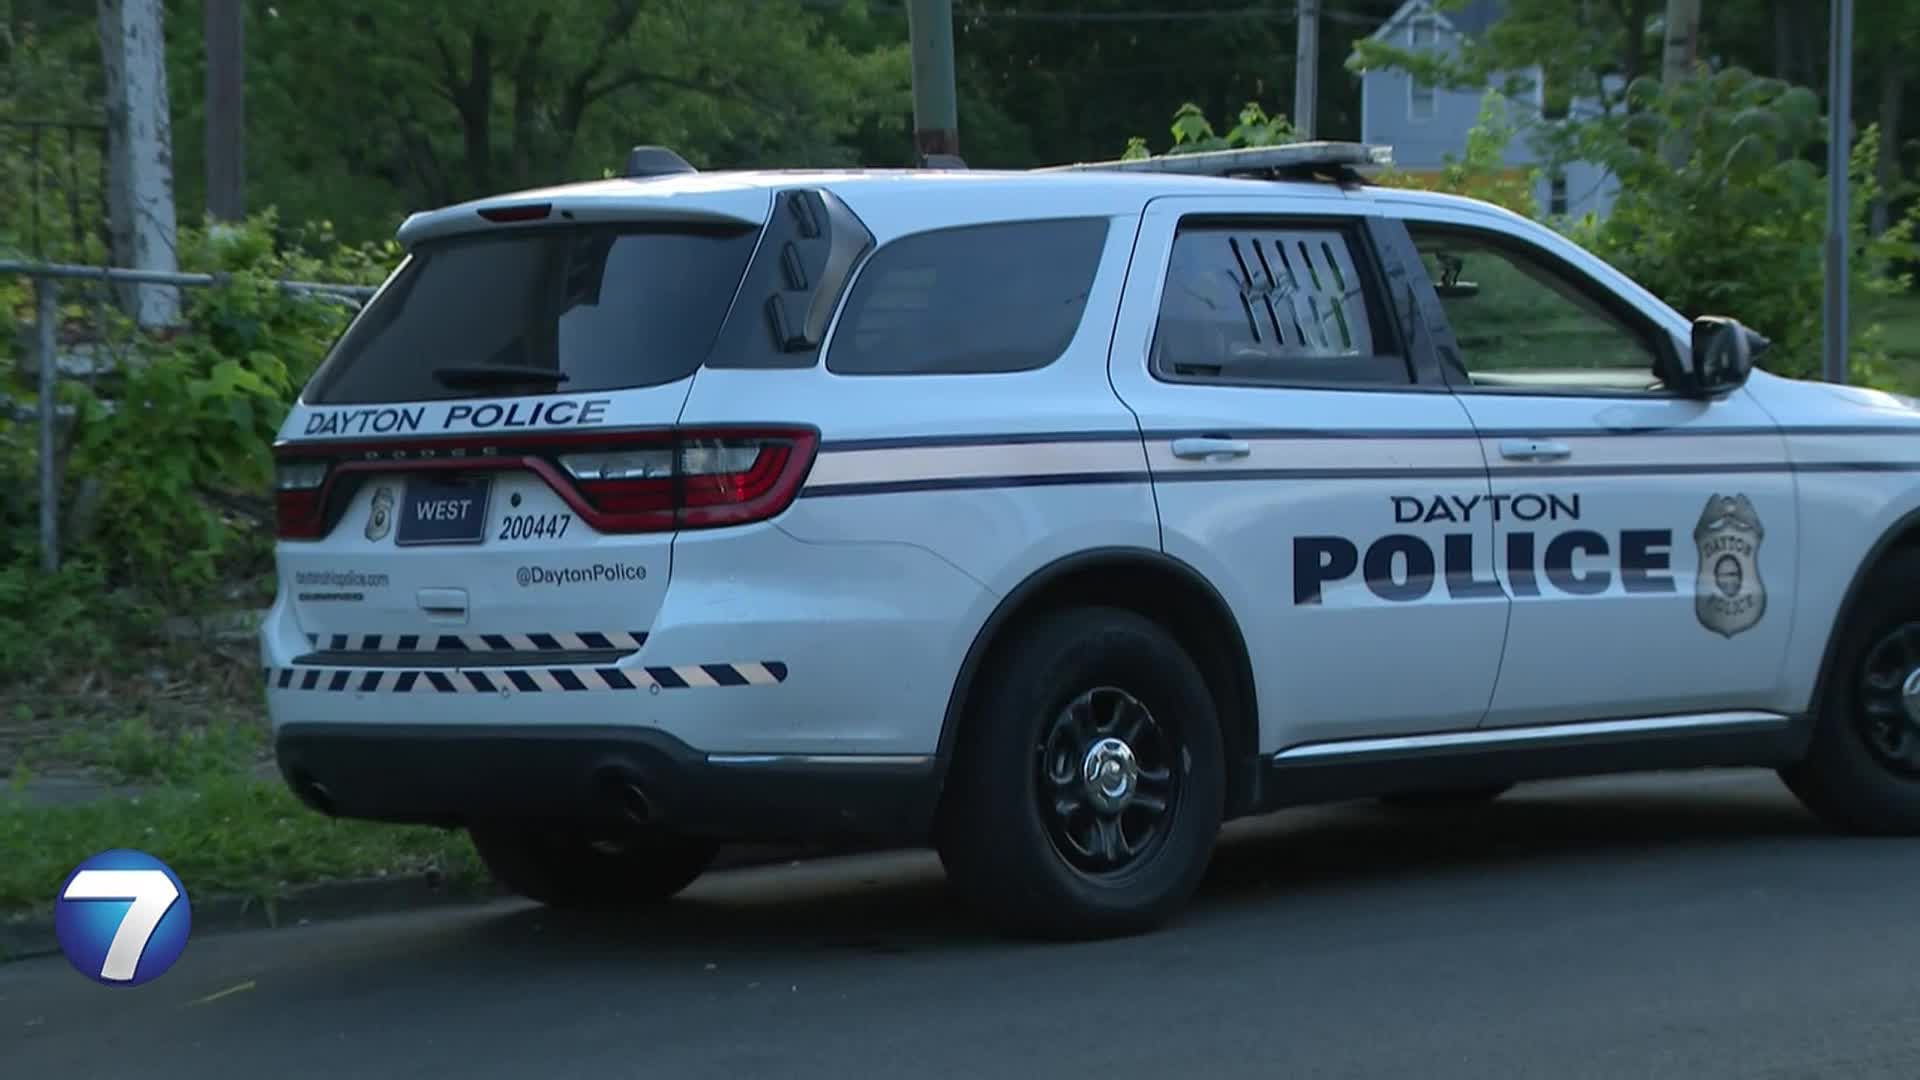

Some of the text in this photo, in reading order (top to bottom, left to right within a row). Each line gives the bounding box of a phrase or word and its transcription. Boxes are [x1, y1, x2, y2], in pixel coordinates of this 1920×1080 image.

[304, 399, 611, 435] DAYTON POLICE
[416, 499, 471, 521] WEST
[1391, 493, 1581, 523] DAYTON
[499, 514, 571, 540] 200447
[516, 562, 647, 587] @DaytonPolice
[1292, 529, 1678, 606] POLICE
